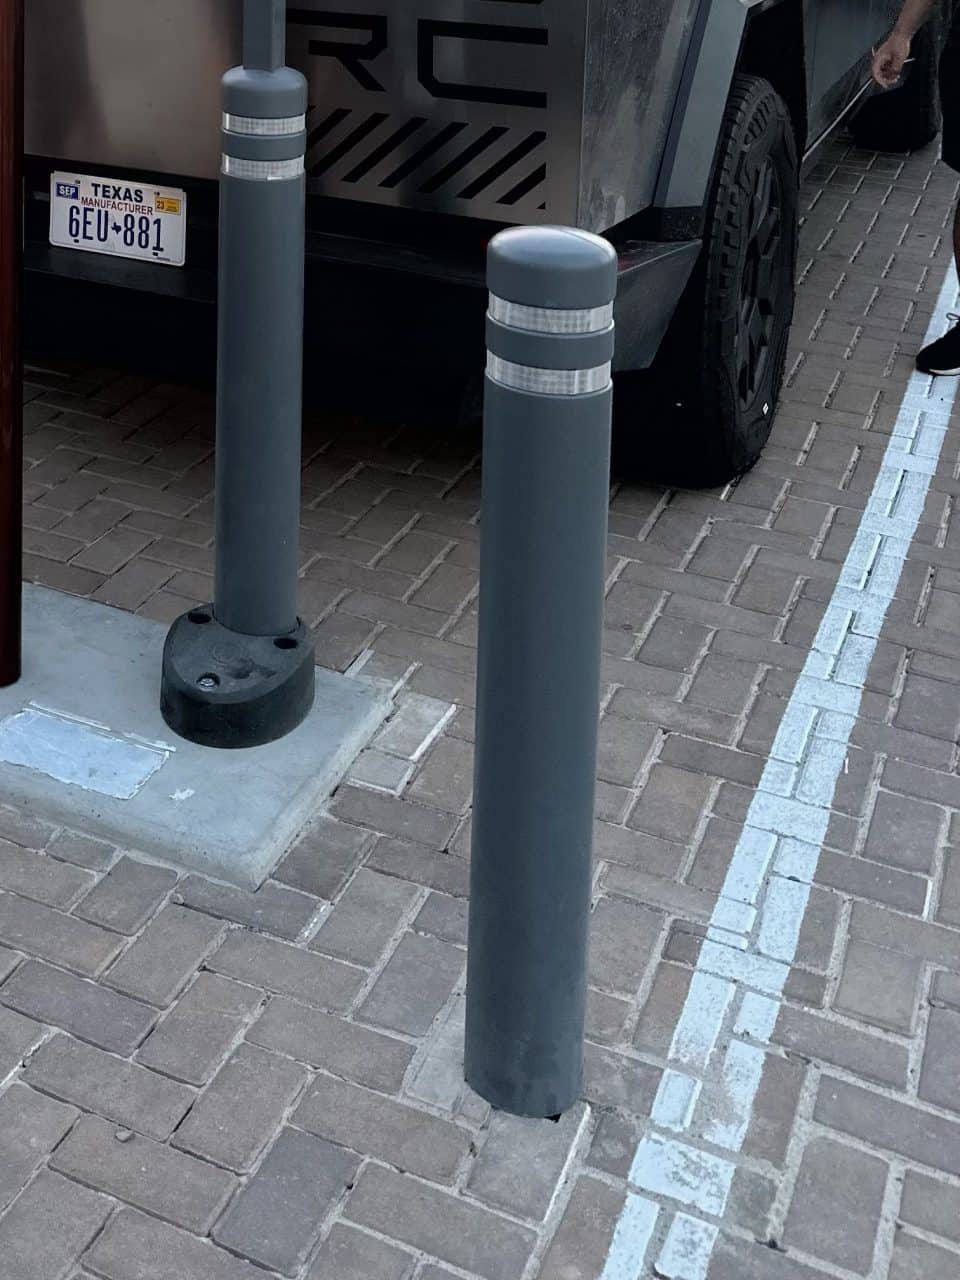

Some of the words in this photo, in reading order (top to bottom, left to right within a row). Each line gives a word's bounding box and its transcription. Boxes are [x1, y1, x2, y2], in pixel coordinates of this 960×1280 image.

[286, 8, 548, 109] RC
[59, 185, 76, 197] SEP
[91, 183, 144, 203] TEXAS
[81, 197, 153, 216] MANUFACTURER
